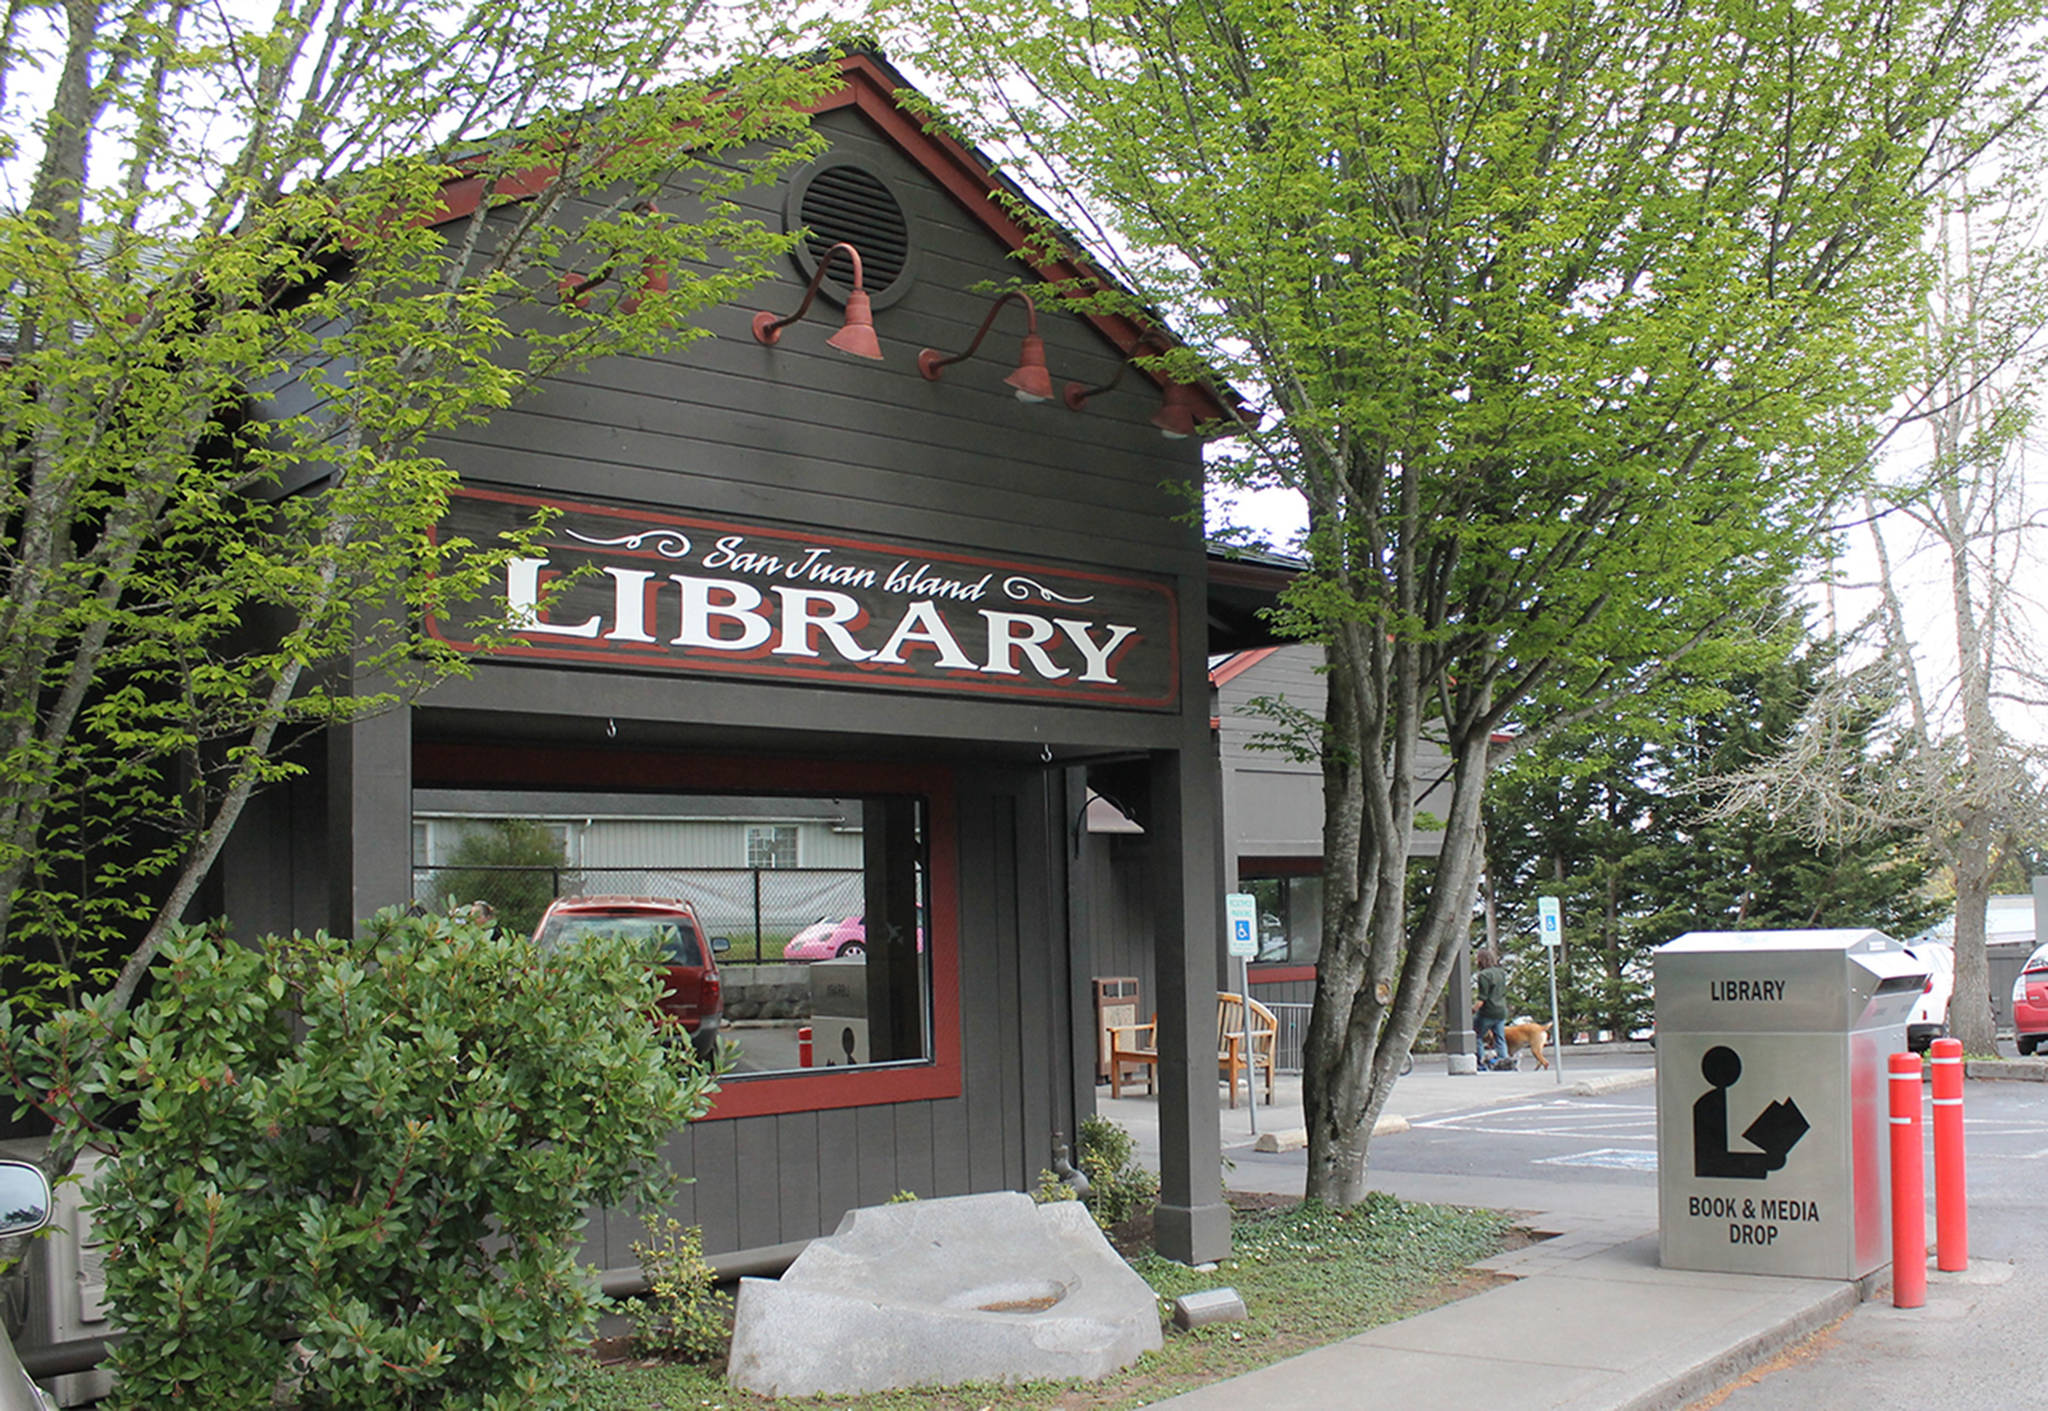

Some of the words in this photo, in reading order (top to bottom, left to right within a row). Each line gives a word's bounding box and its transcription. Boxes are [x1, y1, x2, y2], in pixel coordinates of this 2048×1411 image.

[702, 536, 784, 576] San
[784, 548, 877, 590] Juan
[882, 559, 993, 602] Island
[503, 556, 1136, 684] LIBRARY
[1711, 980, 1785, 1001] LIBRARY
[1689, 1196, 1737, 1218] BOOK
[1742, 1198, 1756, 1219] &
[1761, 1199, 1819, 1222] MEDIA
[1729, 1223, 1778, 1245] DROP
